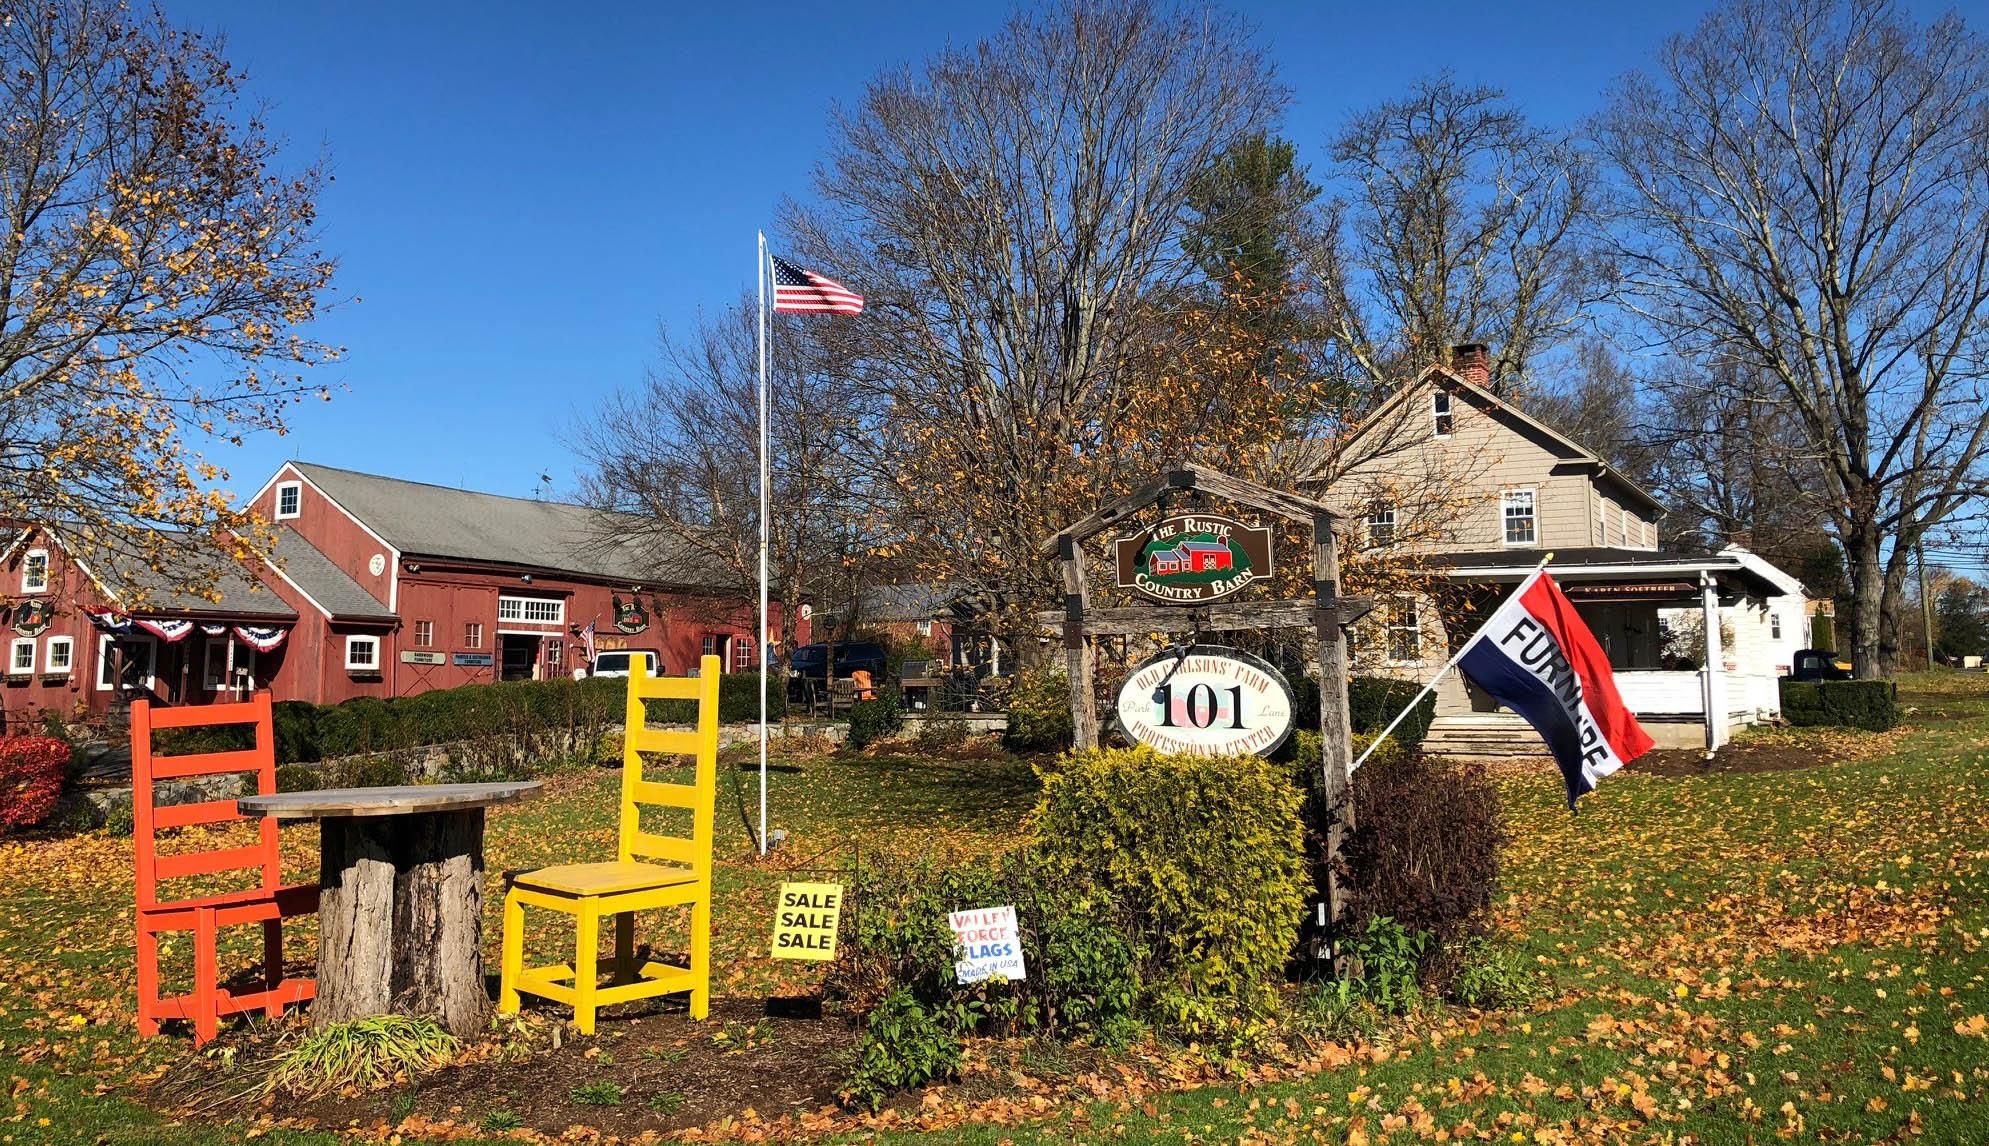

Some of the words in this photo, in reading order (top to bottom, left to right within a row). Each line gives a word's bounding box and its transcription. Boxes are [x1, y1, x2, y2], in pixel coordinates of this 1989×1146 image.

[1148, 524, 1177, 541] THE
[1184, 518, 1233, 537] RUSTIC
[1135, 573, 1202, 599] COUNTRY
[1210, 568, 1254, 595] BARN
[1136, 668, 1162, 691] OLD
[1234, 666, 1270, 694] FARM
[1122, 701, 1151, 713] Park
[1258, 705, 1288, 717] Lane
[1154, 683, 1251, 729] 101
[1226, 725, 1276, 757] CENTER
[783, 892, 837, 909] SALE
[781, 912, 834, 929] SALE
[954, 911, 1010, 928] VALLEY
[778, 933, 832, 950] SALE
[958, 927, 1007, 944] FORGE
[962, 963, 988, 977] MADE
[989, 962, 998, 972] IN
[1000, 960, 1018, 969] USA
